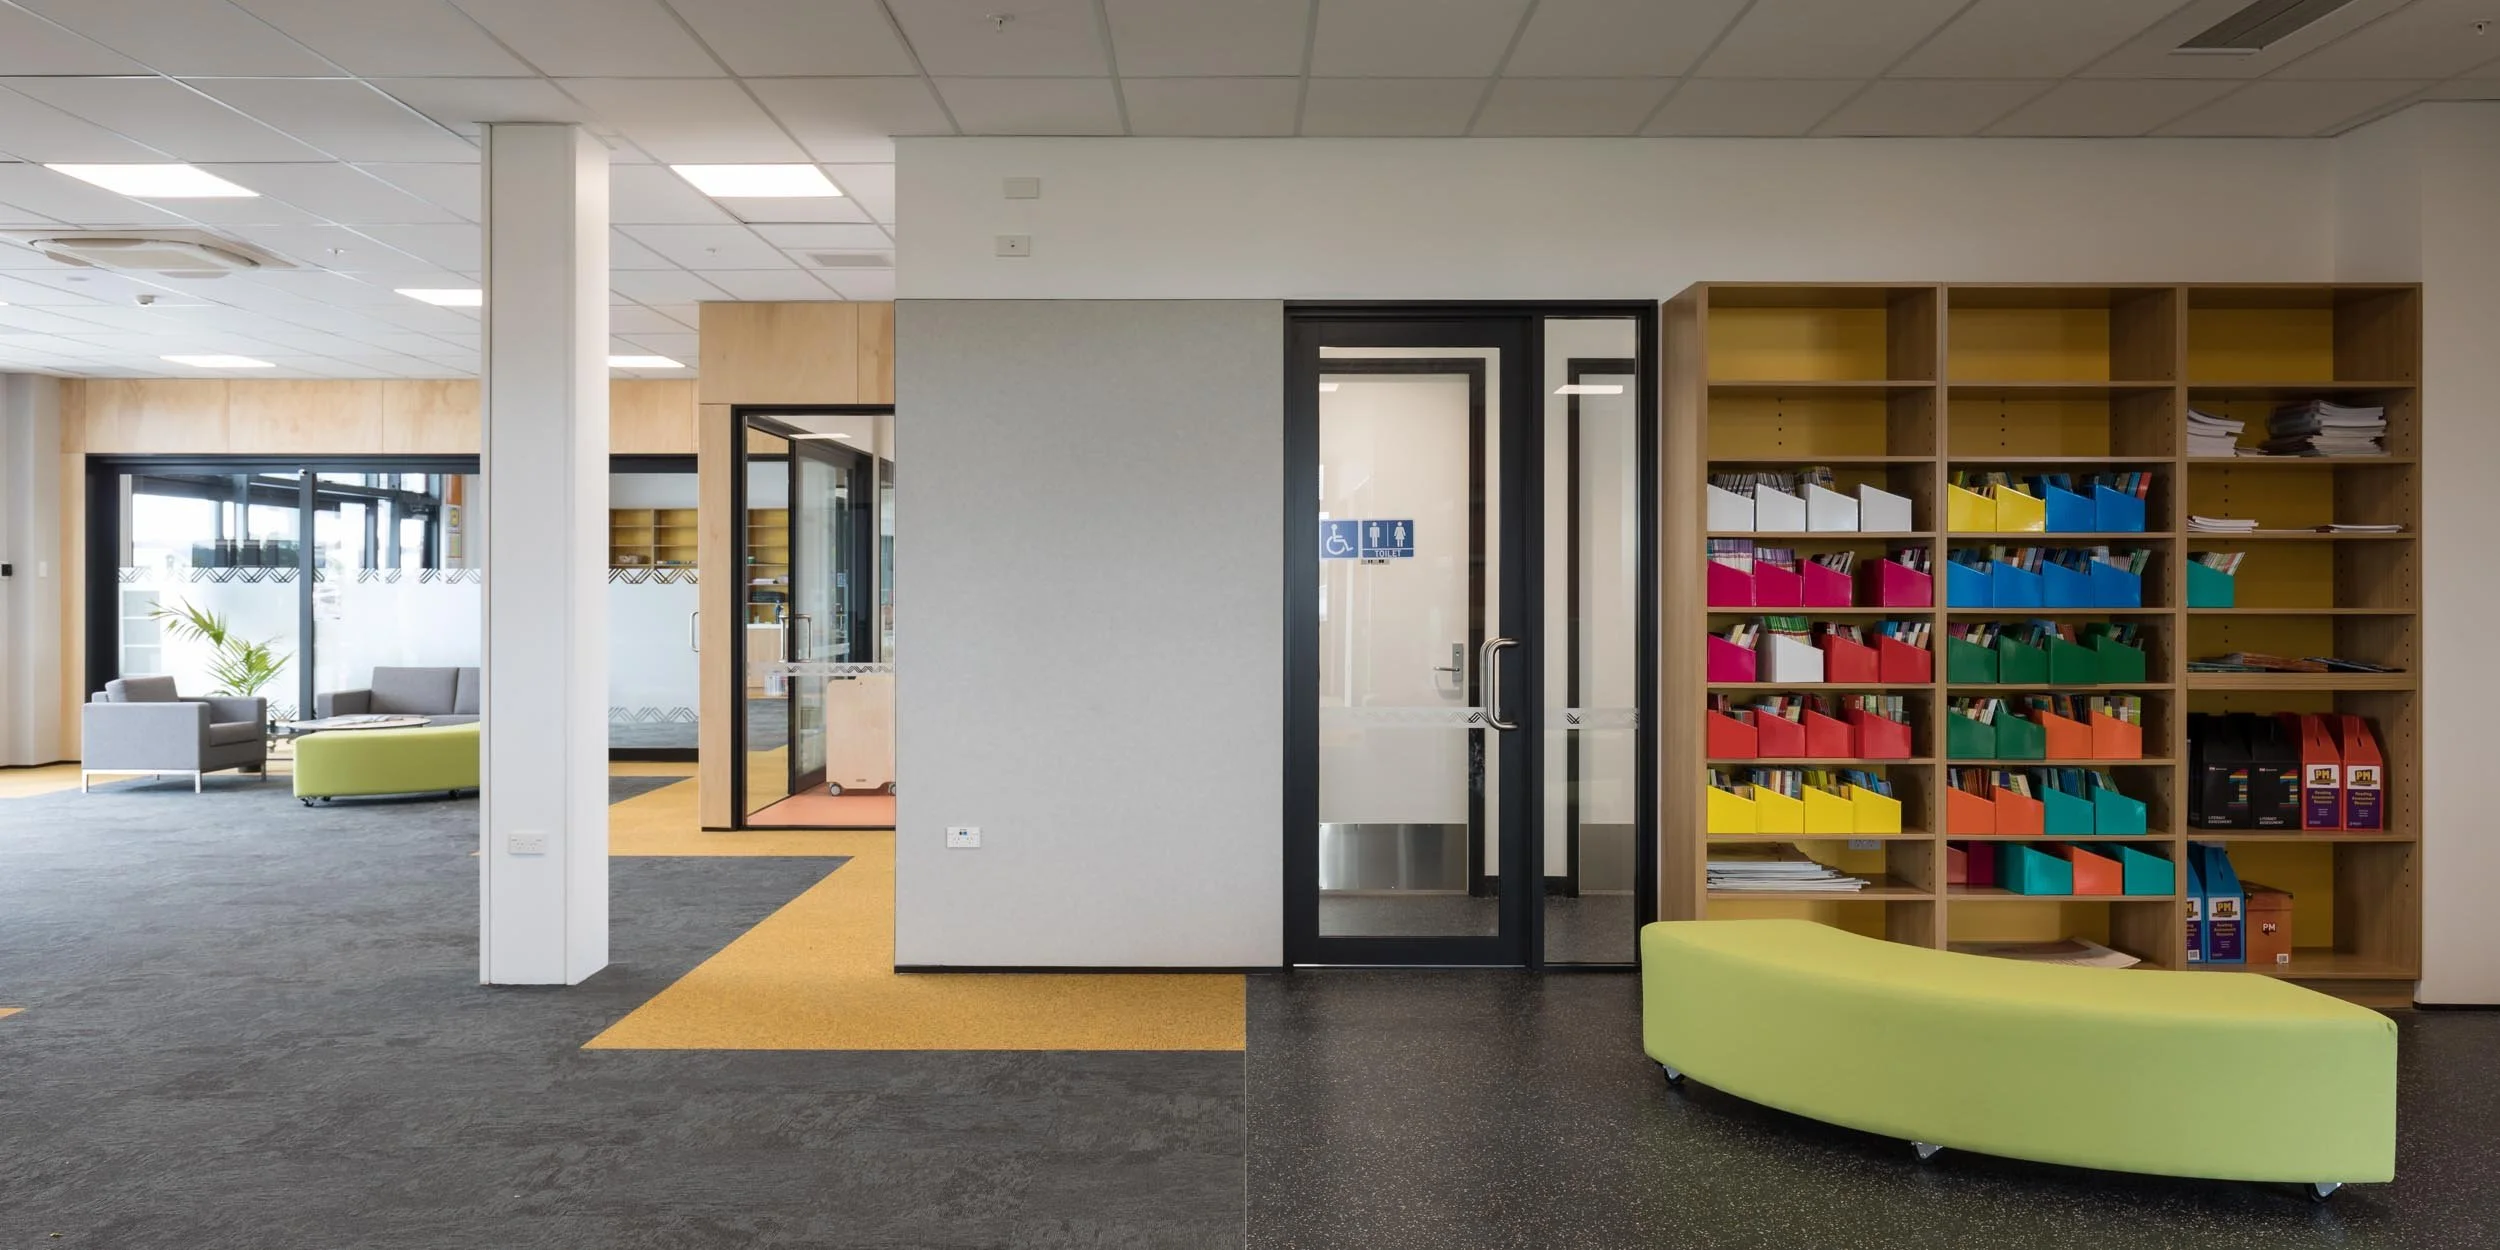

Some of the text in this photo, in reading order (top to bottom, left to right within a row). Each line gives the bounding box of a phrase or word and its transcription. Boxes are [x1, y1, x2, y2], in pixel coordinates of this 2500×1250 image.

[1375, 549, 1401, 557] TOILET
[2315, 770, 2330, 780] PM
[2356, 771, 2371, 781] PM
[2217, 902, 2232, 912] PM
[2263, 923, 2276, 931] PM
